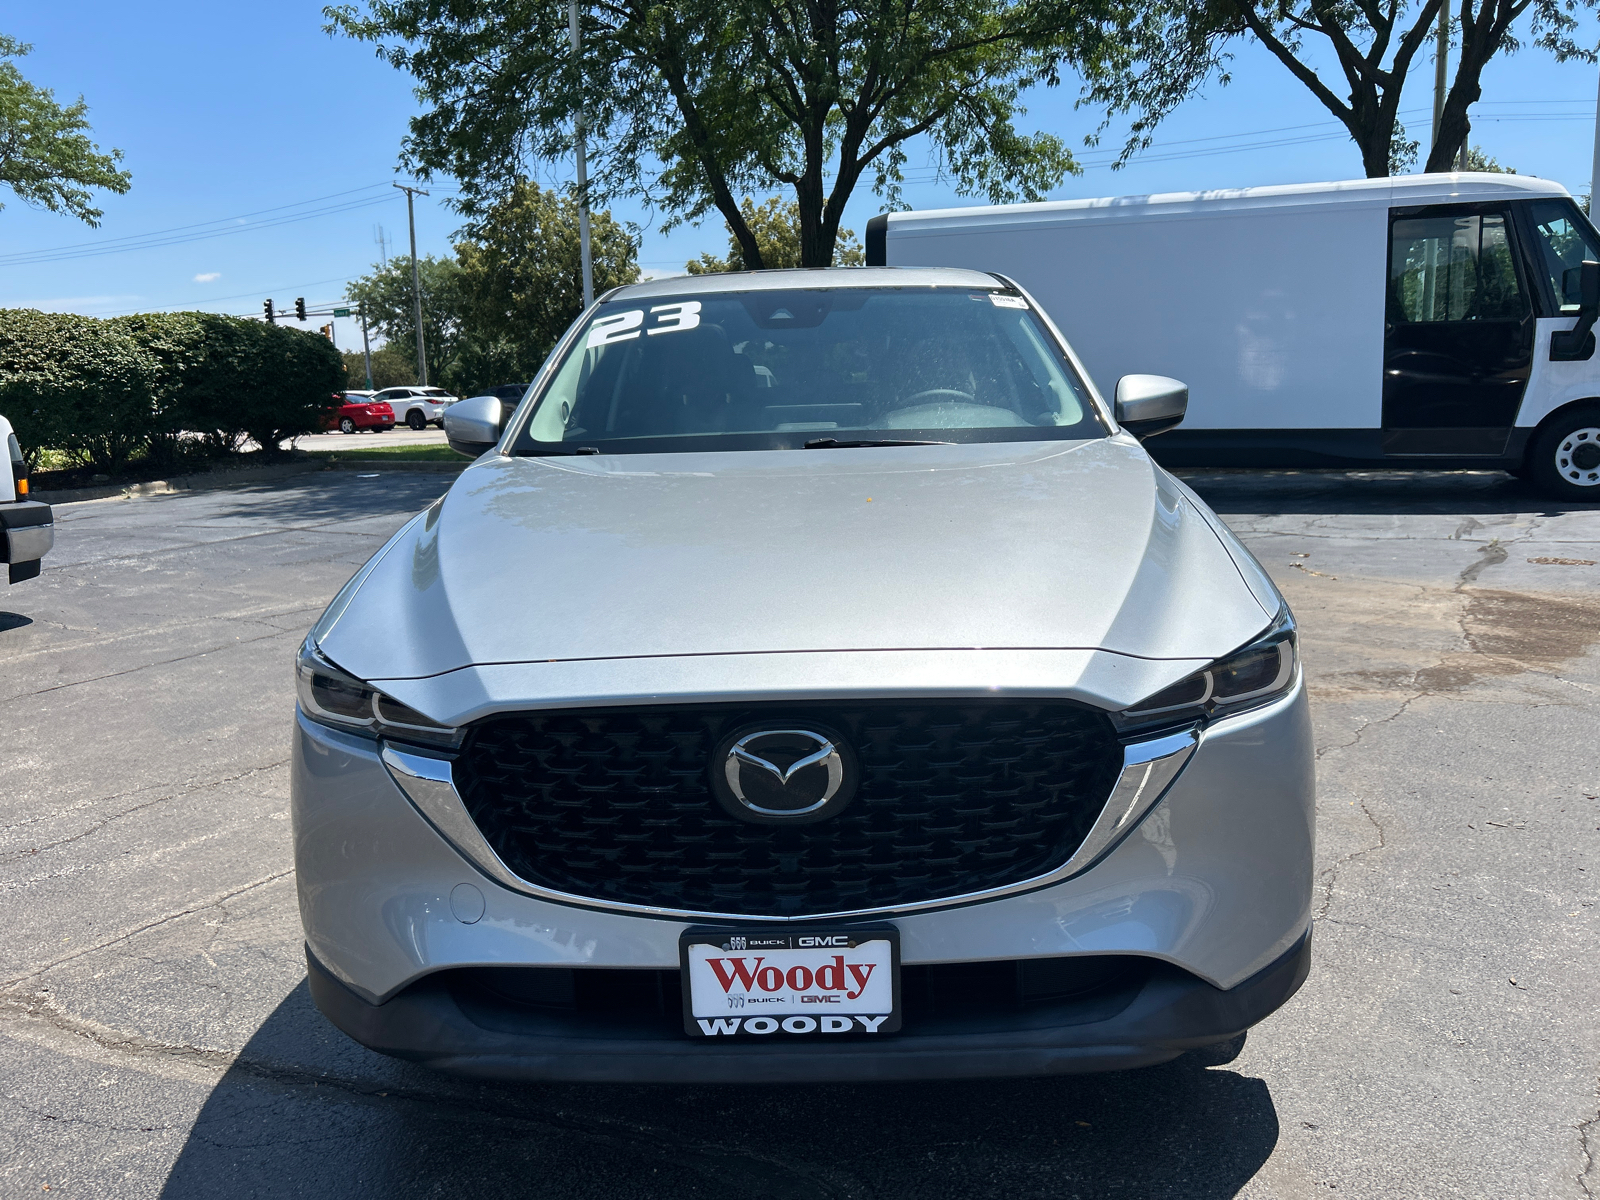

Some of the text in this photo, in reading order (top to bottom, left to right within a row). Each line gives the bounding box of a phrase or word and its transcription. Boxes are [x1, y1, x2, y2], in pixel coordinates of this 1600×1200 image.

[586, 301, 702, 350] 23
[798, 936, 849, 947] GMC
[705, 955, 877, 1000] Woody
[800, 994, 841, 1004] GMC
[696, 1015, 889, 1036] WOODY
